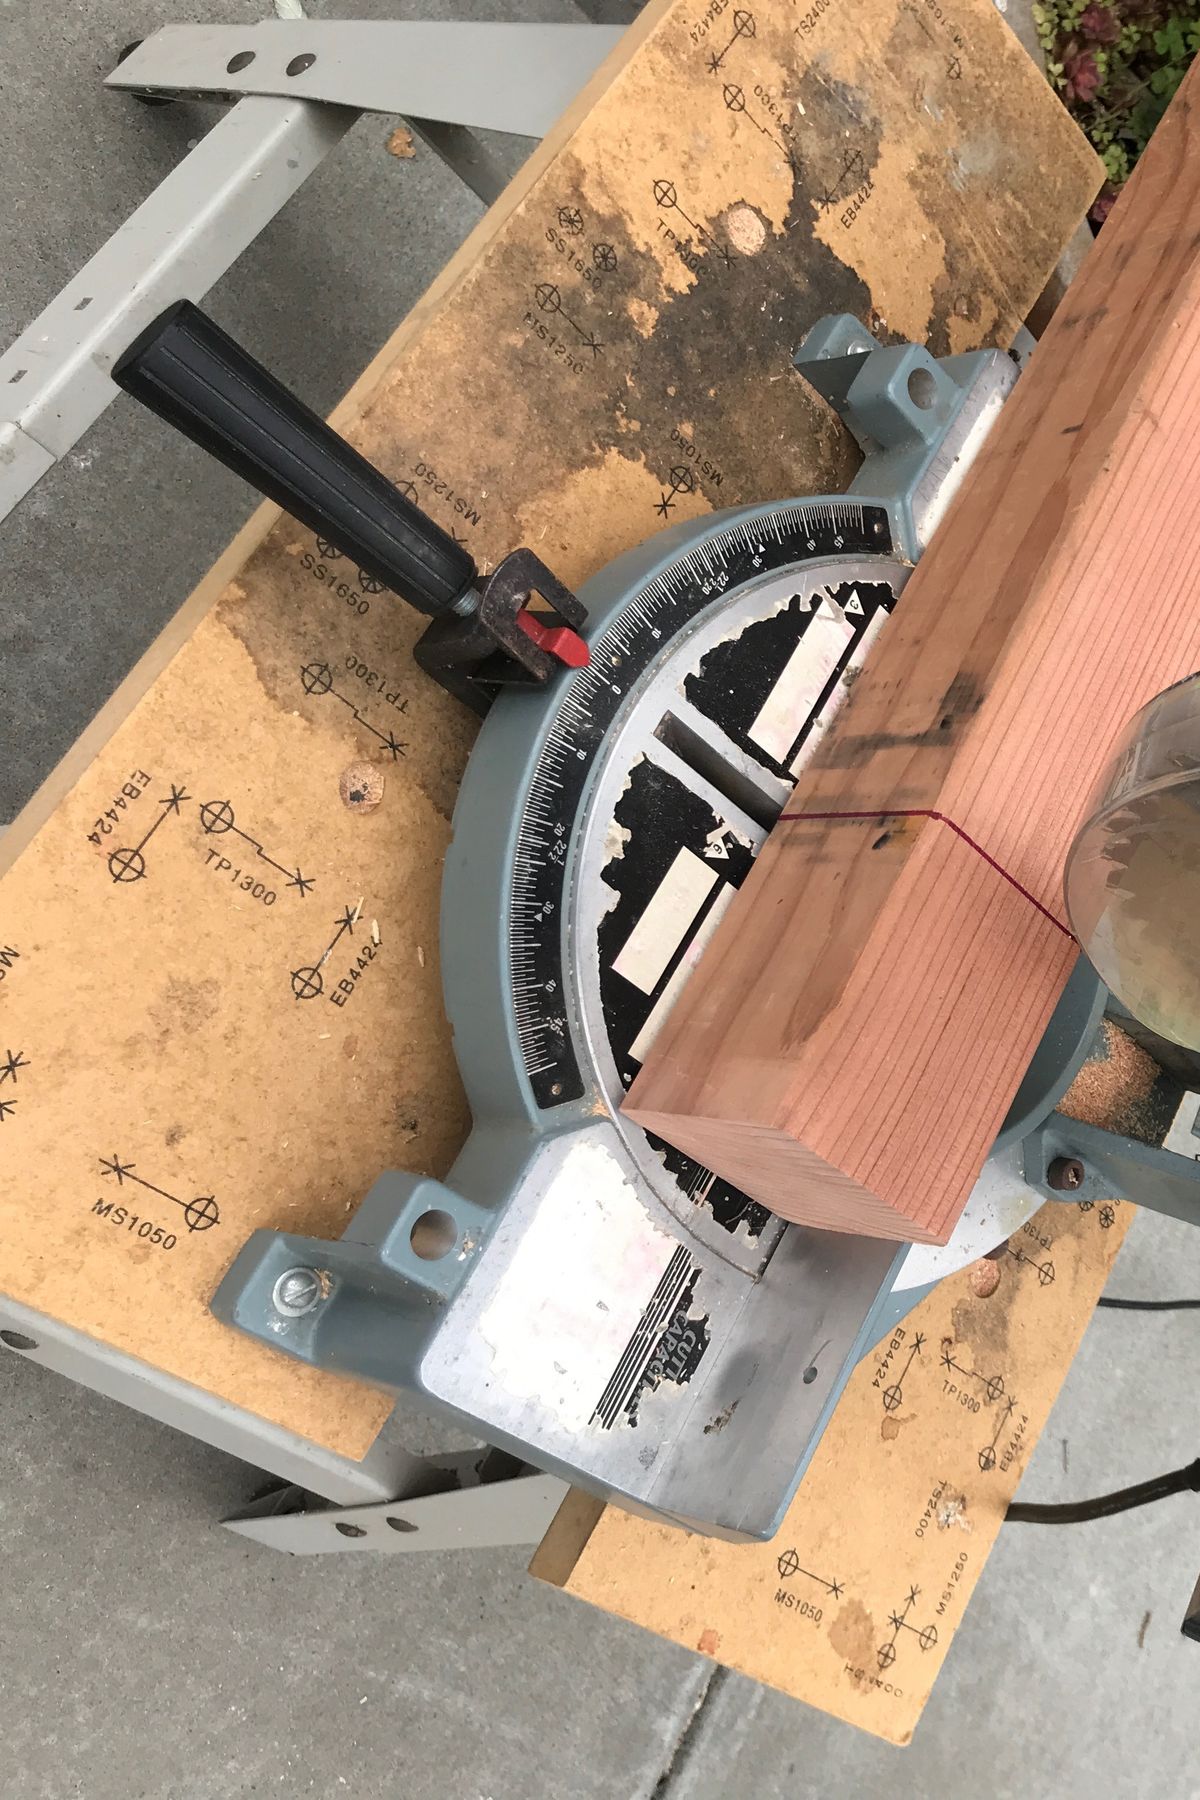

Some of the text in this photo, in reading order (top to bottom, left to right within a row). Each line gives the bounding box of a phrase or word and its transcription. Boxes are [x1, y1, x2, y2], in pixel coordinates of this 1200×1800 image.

[840, 181, 874, 229] EB4424
[545, 227, 603, 289] SS1650
[415, 462, 482, 526] MS1250
[752, 554, 763, 568] 30
[806, 538, 817, 551] 40
[833, 534, 845, 550] 45
[300, 553, 370, 615] SS1650
[702, 583, 713, 596] 20
[651, 627, 662, 639] 10
[345, 655, 409, 714] TP1300
[611, 684, 622, 695] 0
[576, 748, 588, 761] 10
[86, 768, 151, 846] EB4424
[553, 822, 566, 836] 20
[202, 847, 278, 907] TP1300
[542, 900, 555, 915] 30
[329, 935, 383, 1008] EB4424
[545, 978, 557, 993] 40
[91, 1196, 178, 1252] MS1050
[1022, 1221, 1054, 1252] TP130
[872, 1327, 906, 1388] EB4424
[942, 1378, 981, 1414] TP1300
[999, 1415, 1029, 1472] EB4424
[914, 1479, 947, 1538] TS2400
[774, 1587, 824, 1623] MS1050
[935, 1552, 969, 1616] MS1250
